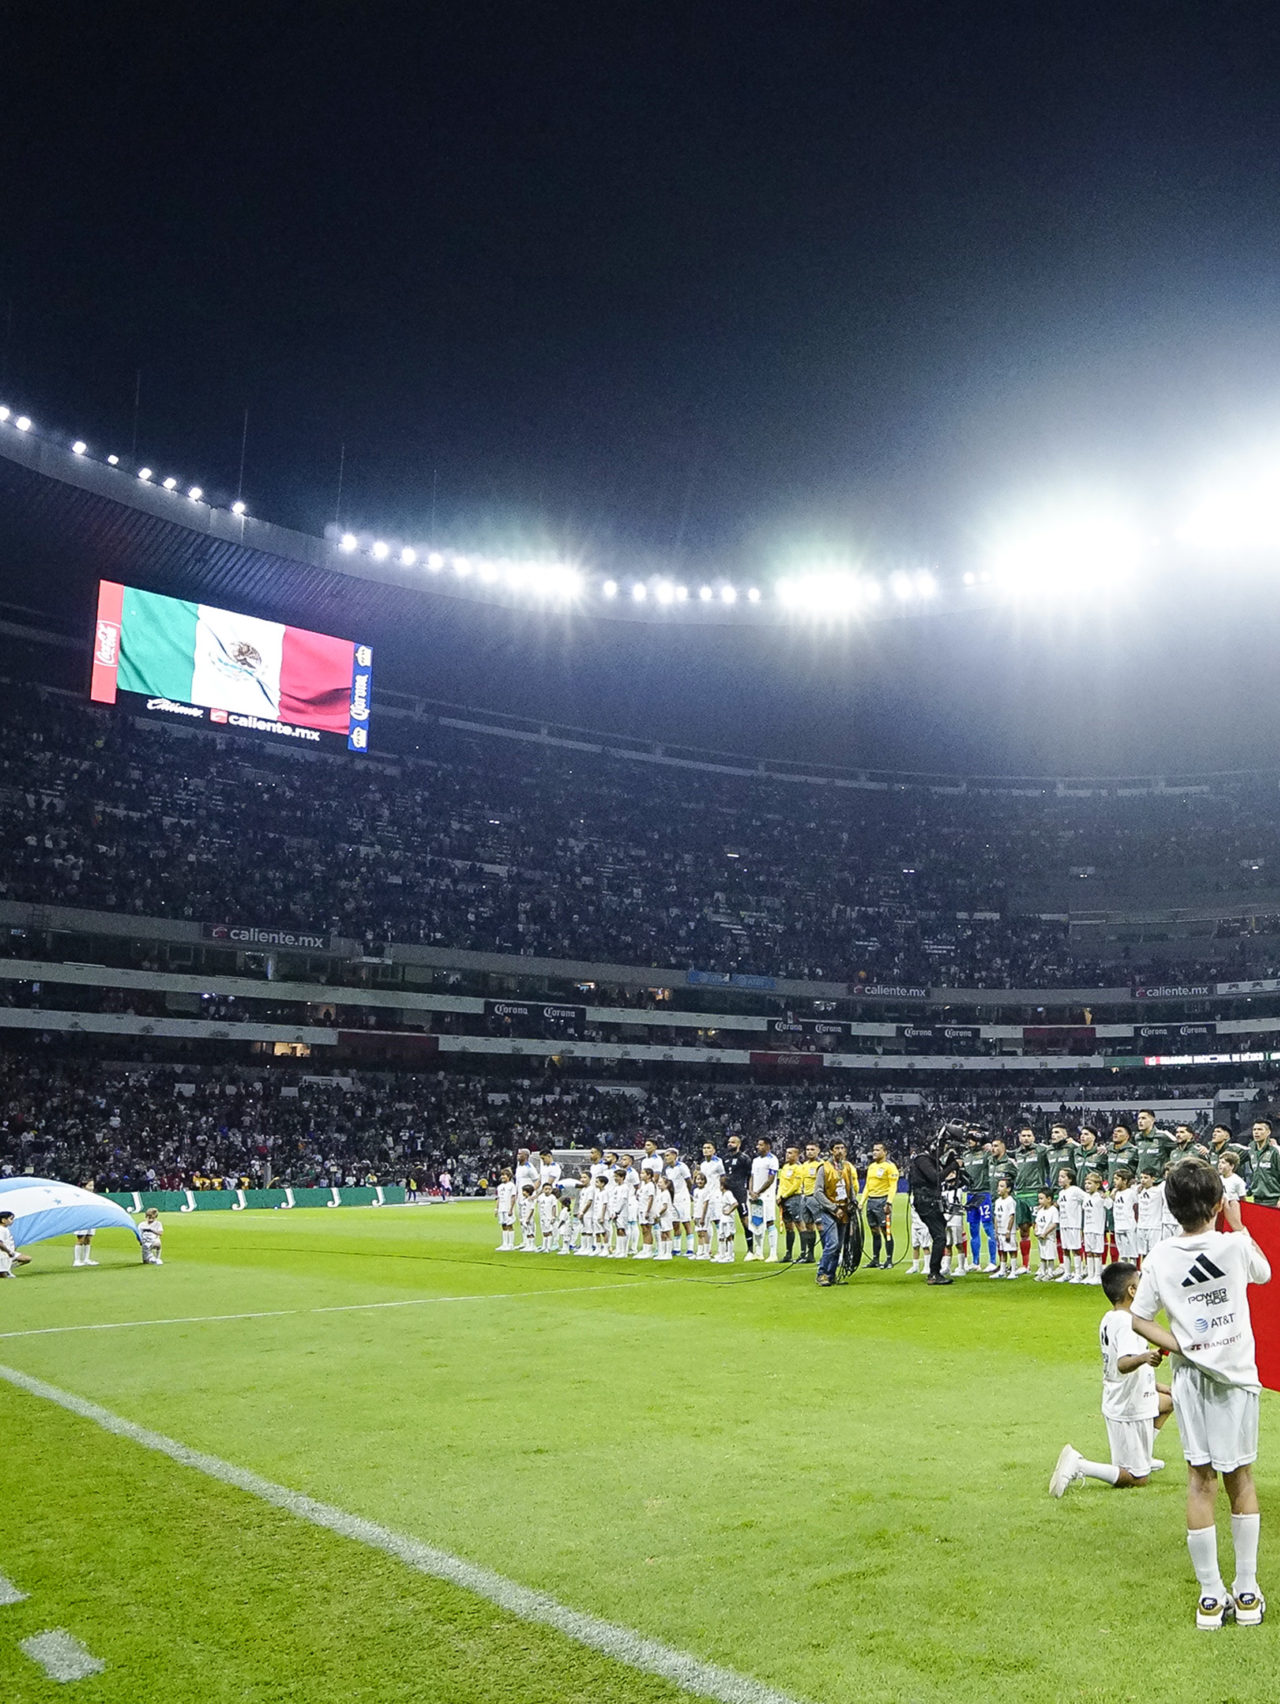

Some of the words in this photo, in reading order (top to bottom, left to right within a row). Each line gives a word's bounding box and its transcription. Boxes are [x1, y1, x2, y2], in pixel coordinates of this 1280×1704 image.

[350, 674, 371, 721] Corona
[228, 713, 321, 741] caliente.mx
[230, 928, 324, 949] caliente.mx
[864, 985, 926, 997] caliente.mx
[1146, 985, 1209, 998] caliente.mx
[494, 1004, 529, 1016] Corona
[543, 1006, 576, 1018] Corona
[775, 1021, 803, 1032] Corona
[815, 1023, 842, 1033] Corona
[904, 1027, 933, 1038] Corona
[944, 1028, 972, 1039] Corona
[1140, 1027, 1168, 1037] Corona
[1179, 1025, 1207, 1036] Corona
[979, 1204, 991, 1216] 12
[1188, 1288, 1227, 1305] POWER
[1211, 1313, 1236, 1328] AT&T
